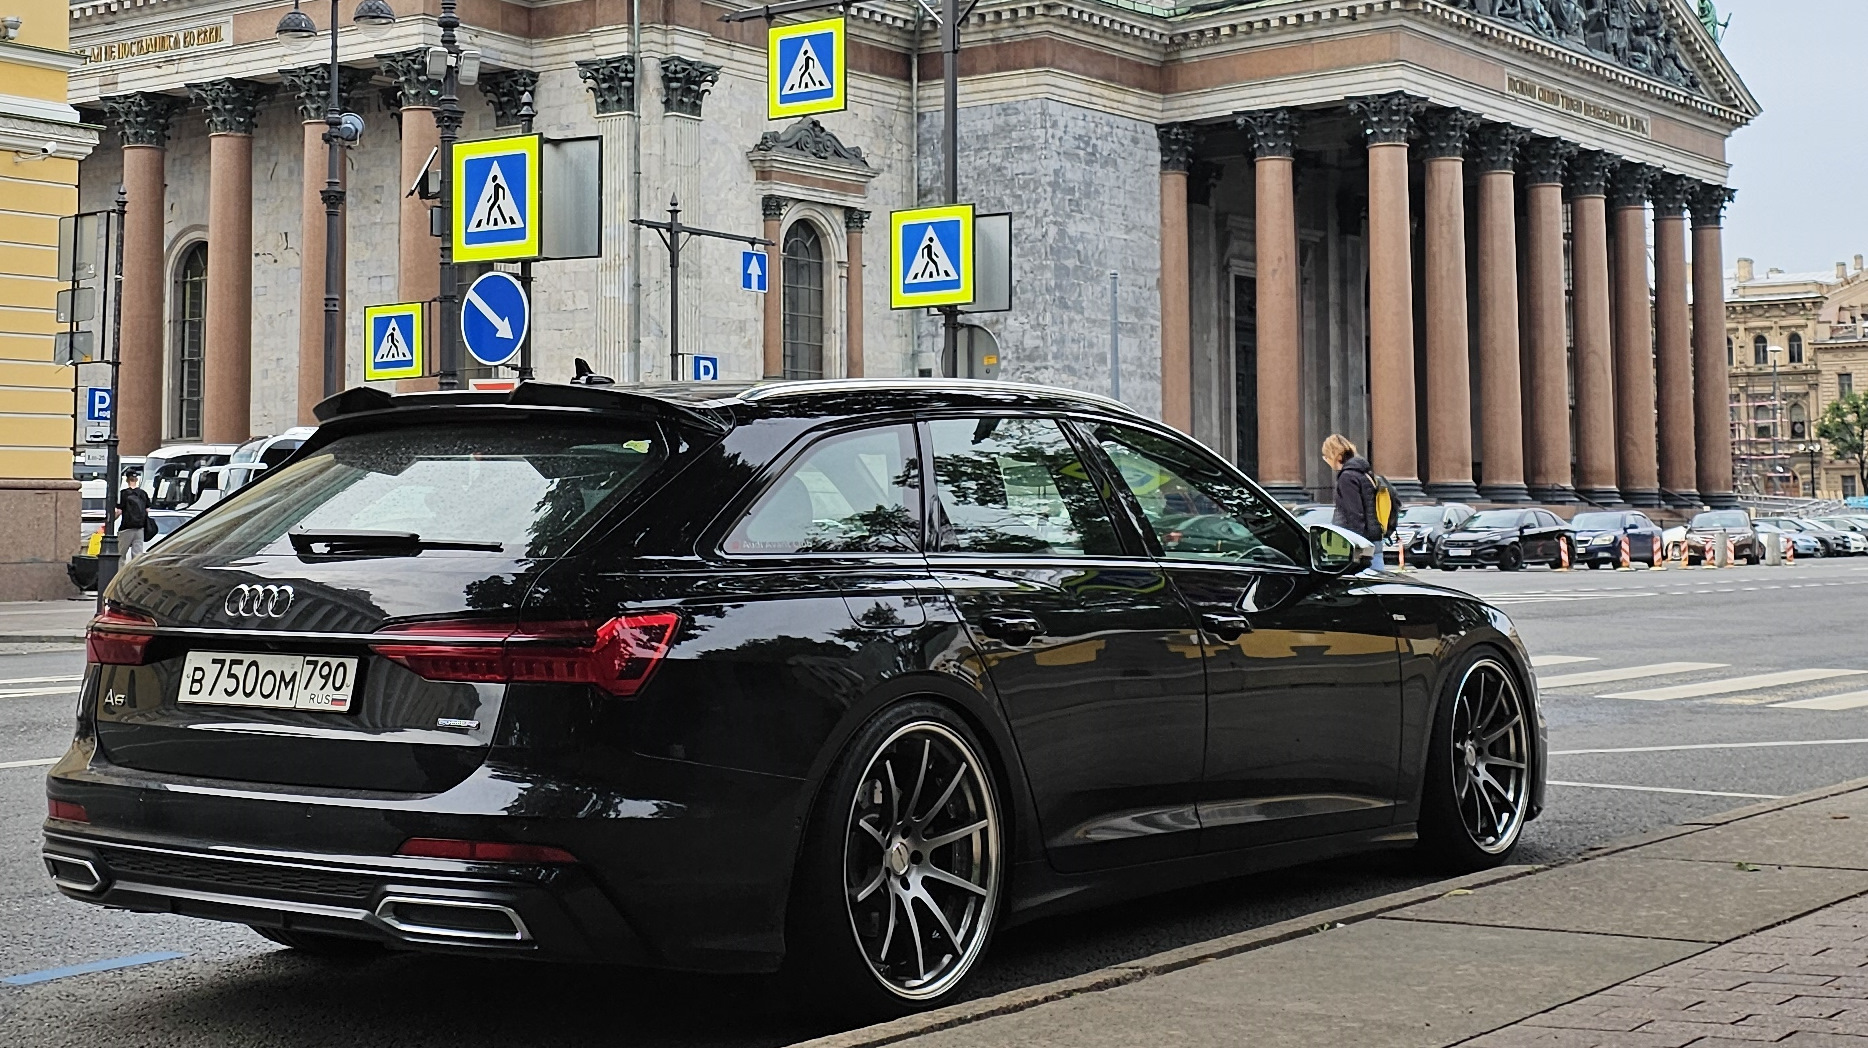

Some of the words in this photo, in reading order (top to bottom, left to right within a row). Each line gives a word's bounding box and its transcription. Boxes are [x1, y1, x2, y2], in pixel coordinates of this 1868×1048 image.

[94, 390, 111, 418] P
[304, 659, 348, 691] 790
[105, 688, 126, 706] A6
[308, 693, 331, 705] RUS
